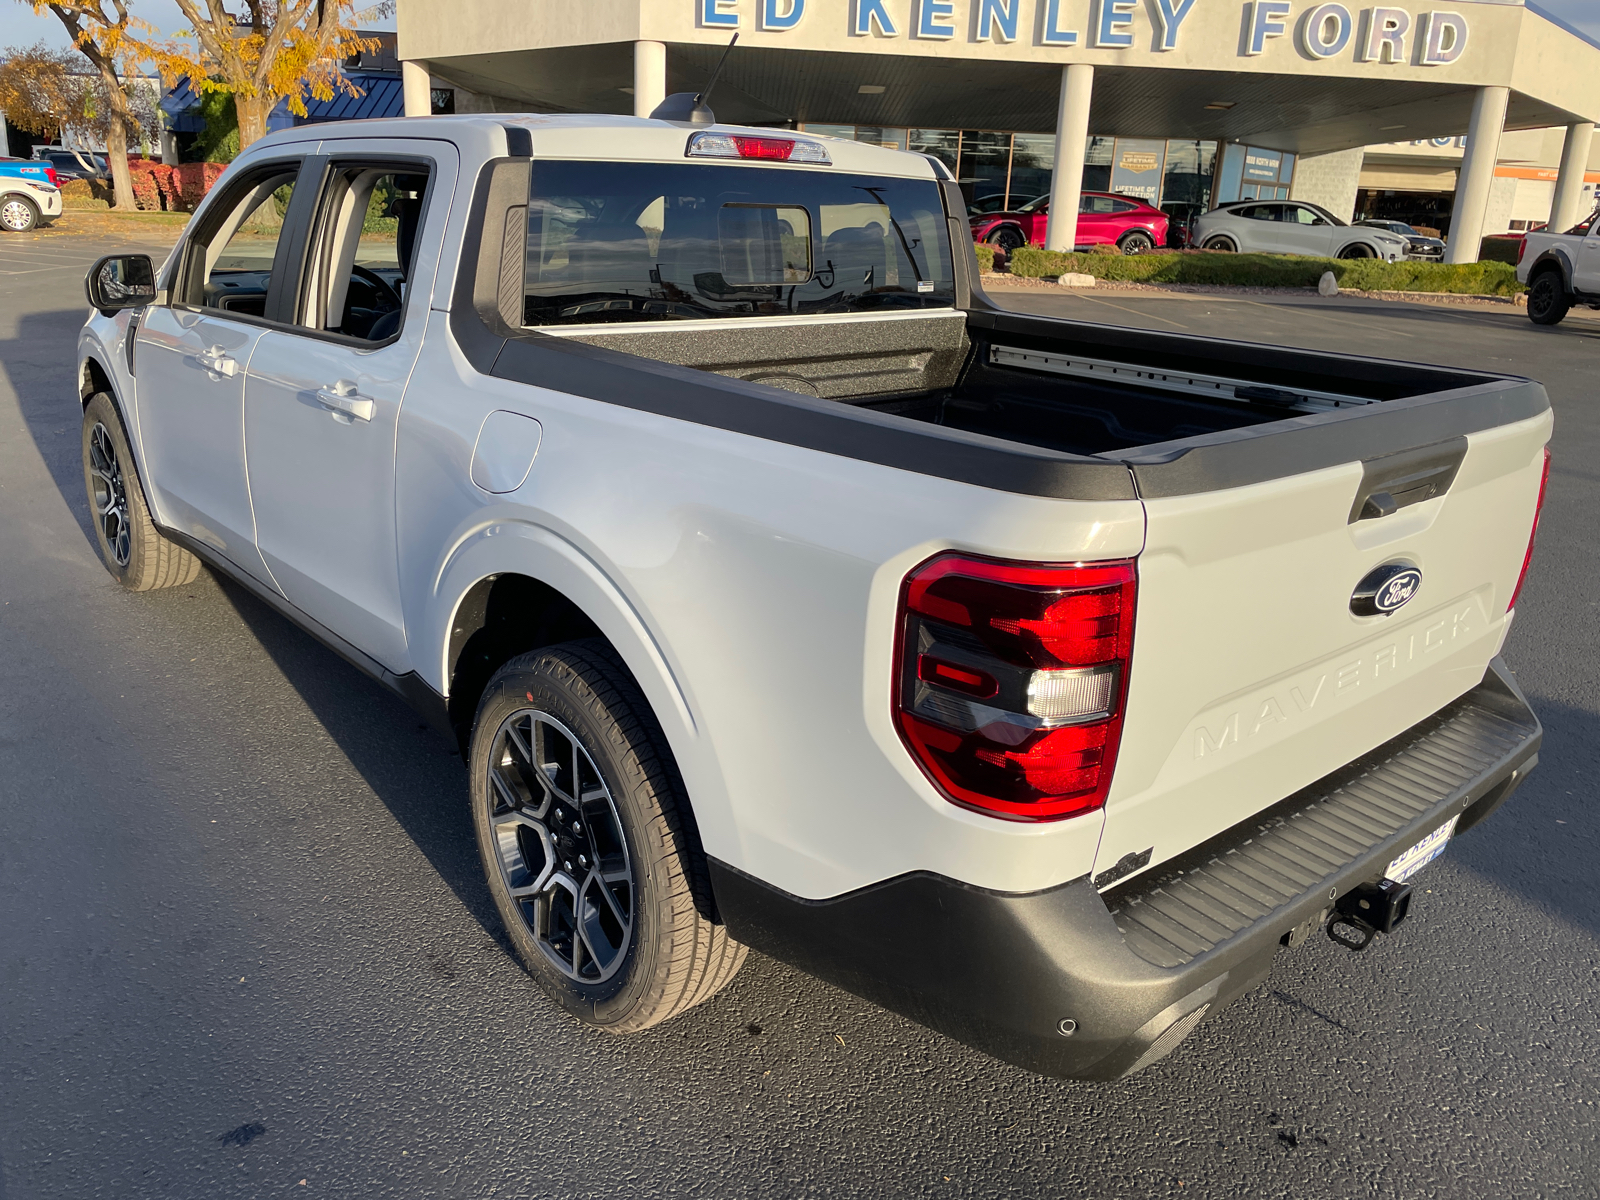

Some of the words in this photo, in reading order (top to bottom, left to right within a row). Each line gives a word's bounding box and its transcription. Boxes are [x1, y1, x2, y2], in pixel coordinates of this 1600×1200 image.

[701, 0, 806, 30] ED
[855, 0, 1196, 50] KENLEY
[1246, 1, 1470, 65] FORD
[1384, 576, 1415, 606] Ford
[1192, 605, 1472, 760] MAVERICK
